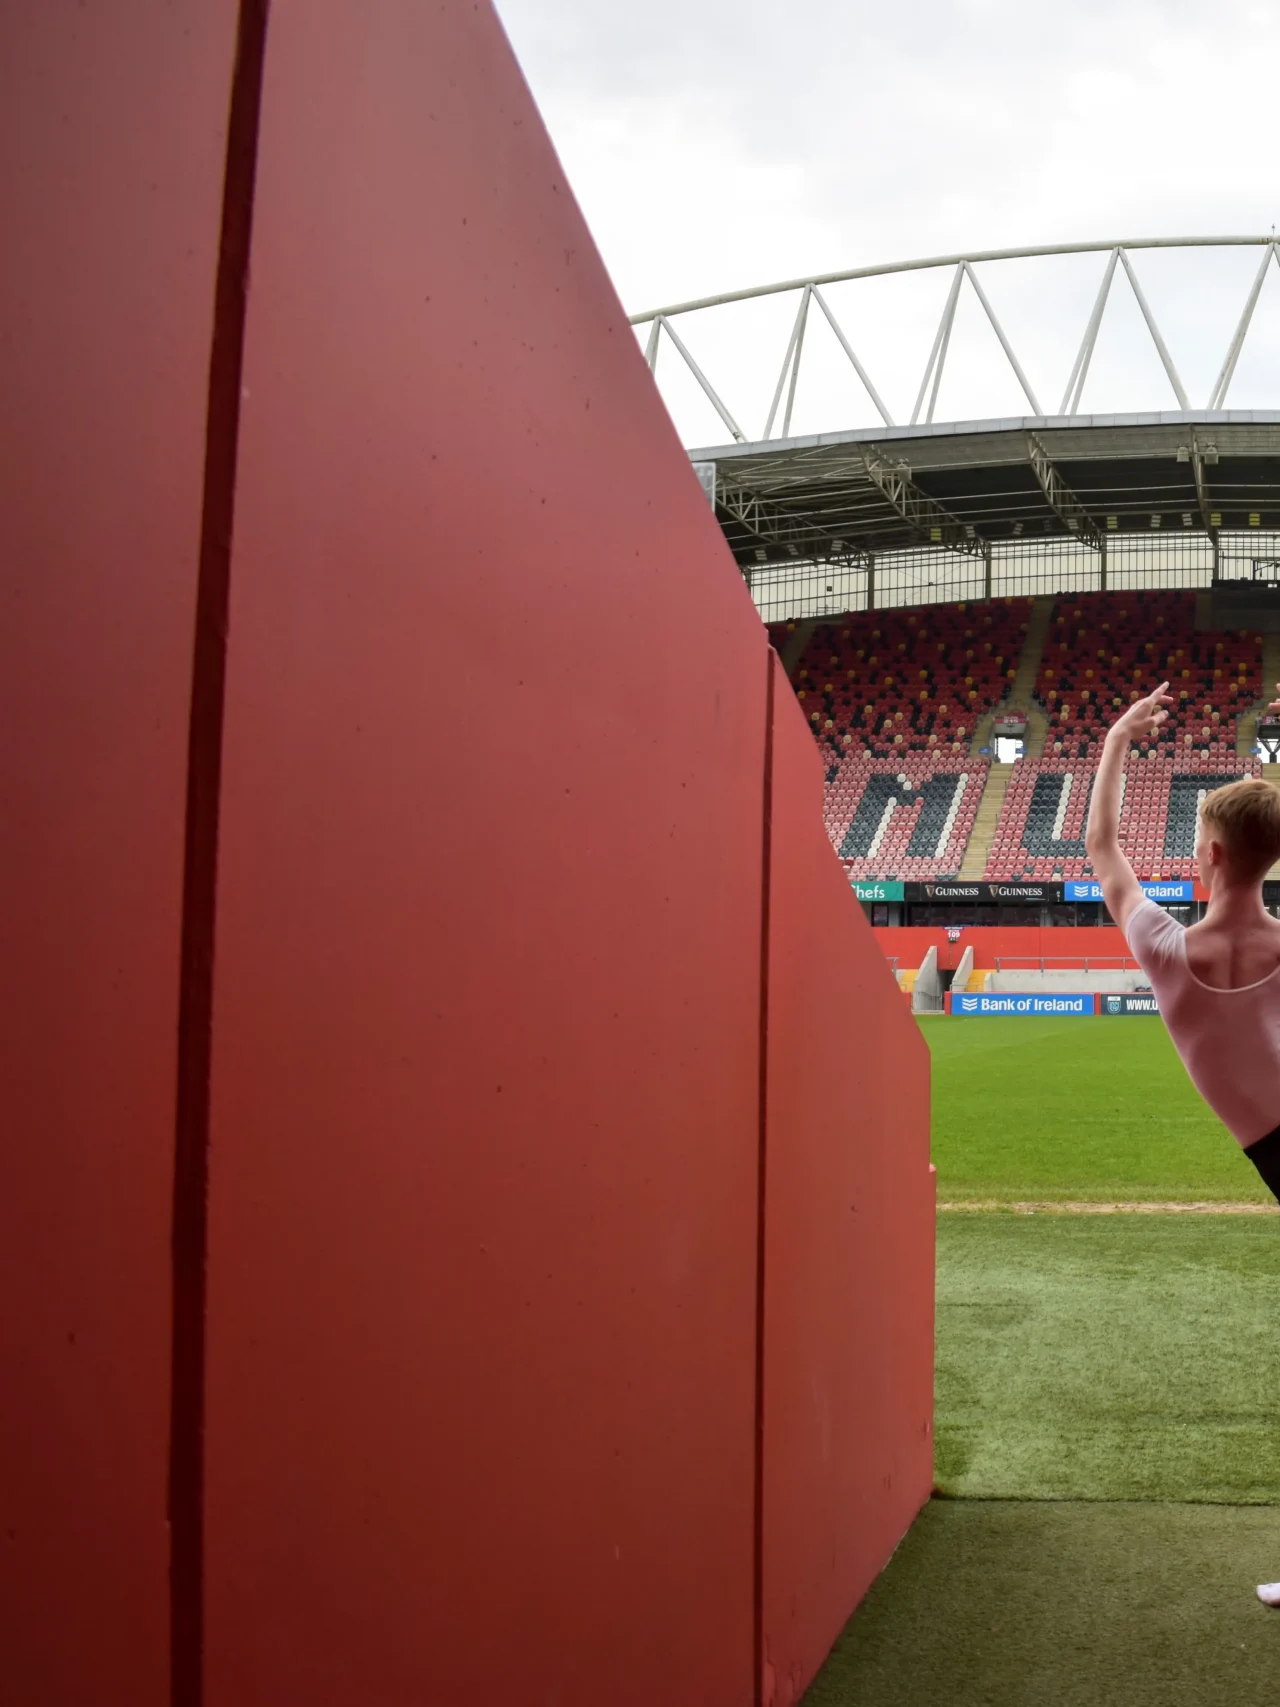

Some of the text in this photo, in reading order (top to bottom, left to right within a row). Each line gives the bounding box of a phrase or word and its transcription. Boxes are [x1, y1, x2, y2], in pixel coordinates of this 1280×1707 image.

[851, 885, 885, 899] hefs
[935, 886, 979, 896] GUINNESS
[999, 886, 1043, 896] GUINNESS
[1140, 885, 1183, 897] reland
[981, 998, 1082, 1011] Bank of Ireland
[1126, 999, 1159, 1010] WWW.U
